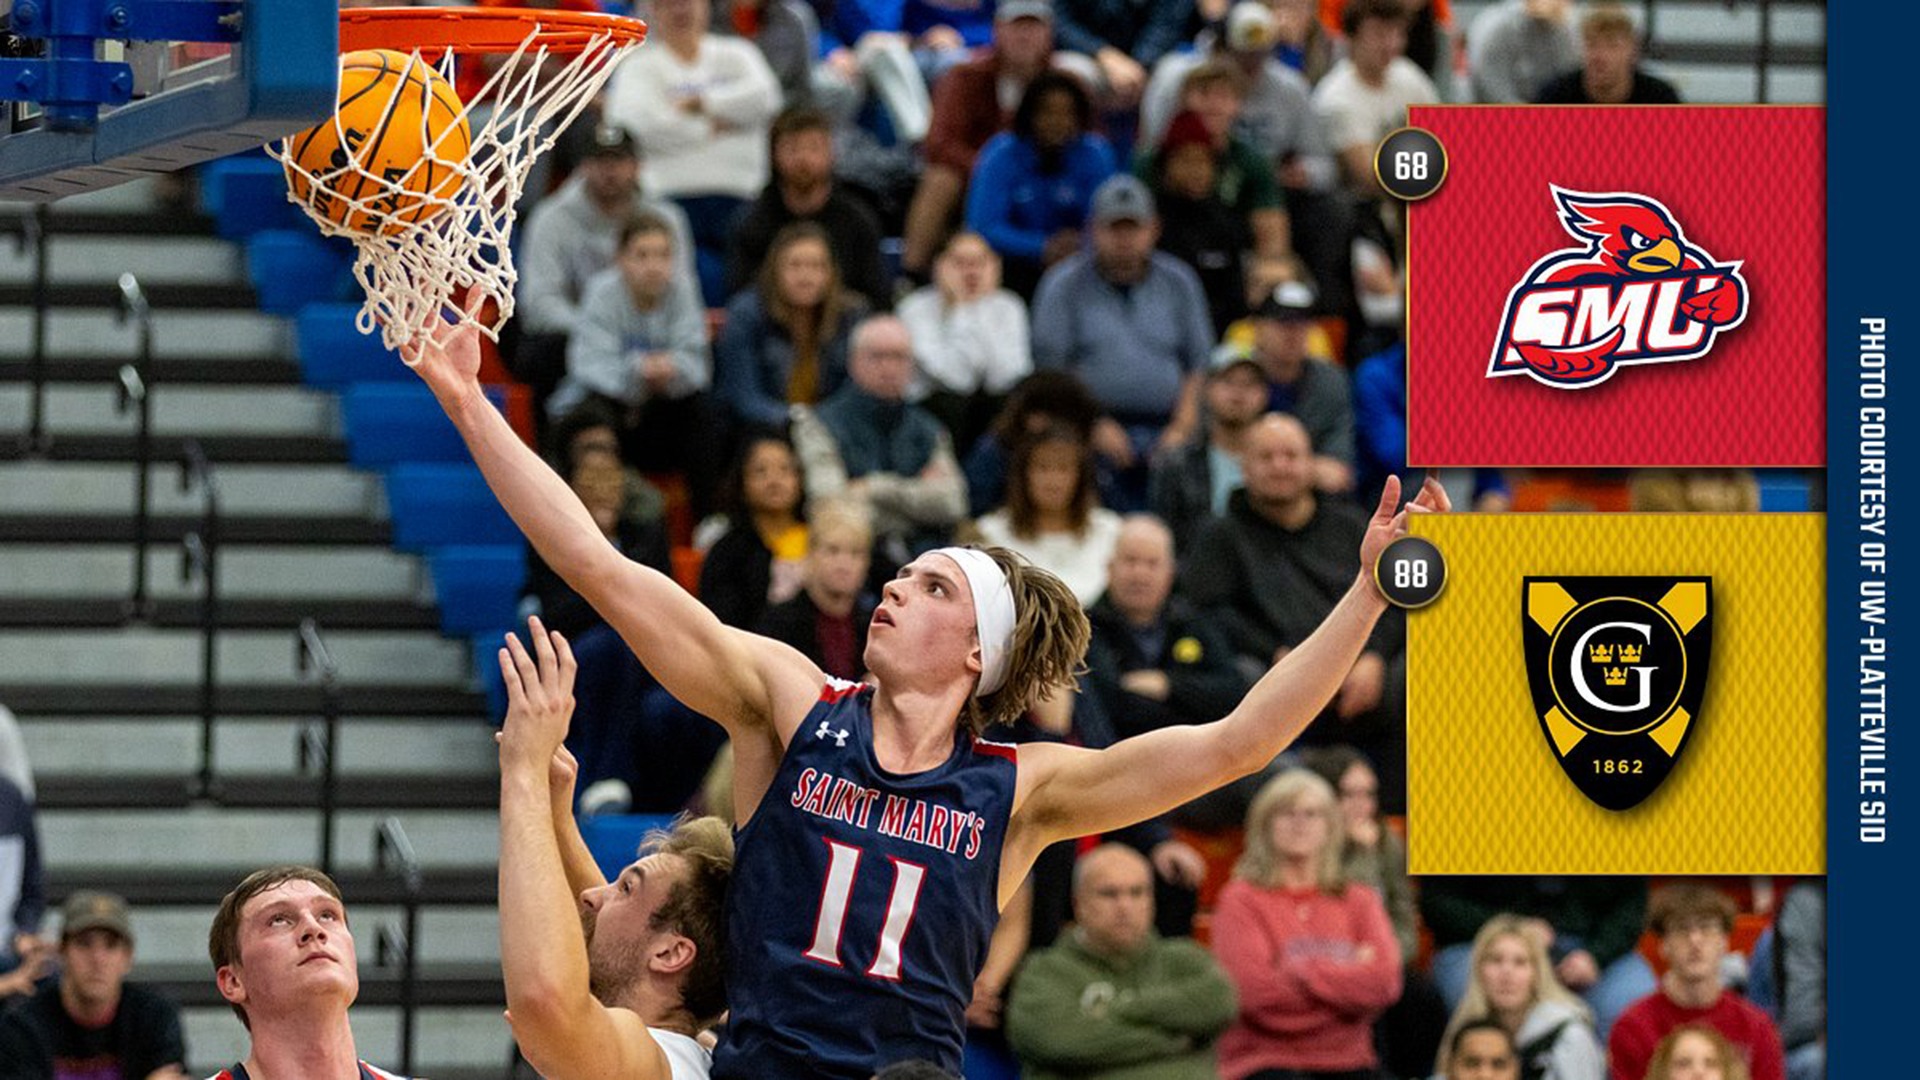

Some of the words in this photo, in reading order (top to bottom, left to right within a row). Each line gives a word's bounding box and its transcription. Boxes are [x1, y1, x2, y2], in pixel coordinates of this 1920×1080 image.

[791, 767, 880, 829] SAINT
[877, 794, 985, 860] MARY'S
[801, 835, 928, 983] 11
